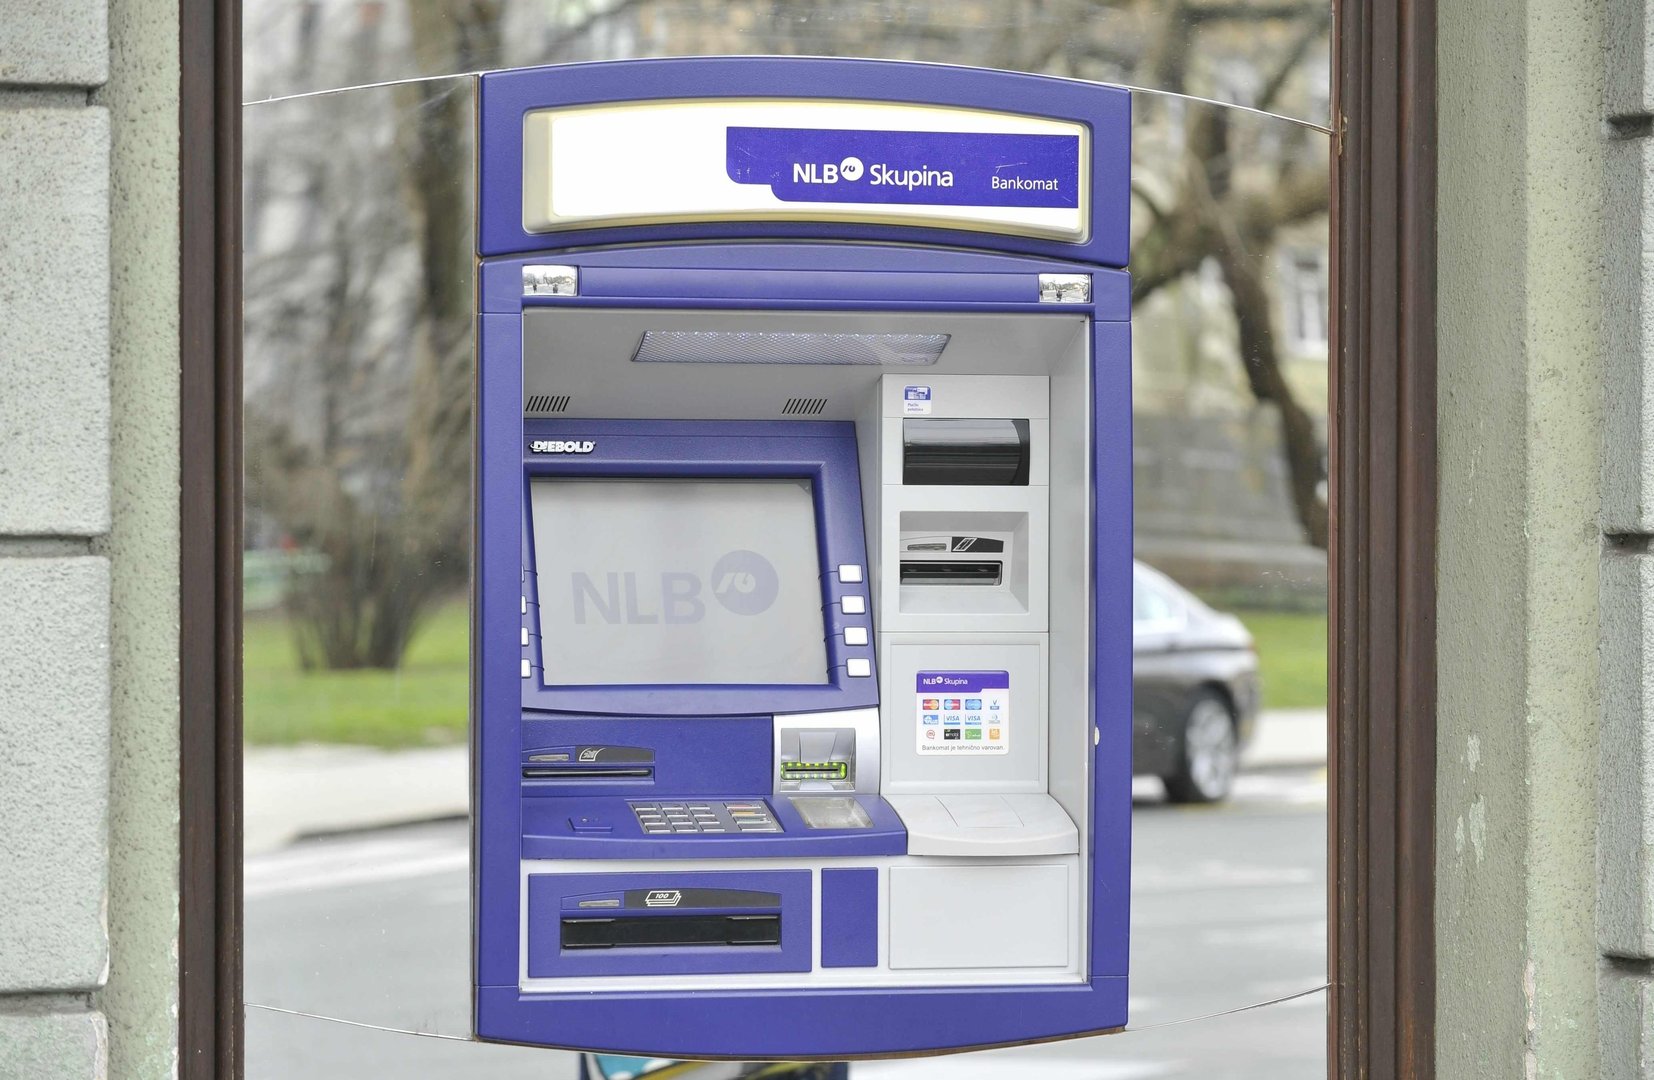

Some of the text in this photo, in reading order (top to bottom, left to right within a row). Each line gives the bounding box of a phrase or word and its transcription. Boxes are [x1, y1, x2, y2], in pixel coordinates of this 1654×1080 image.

[793, 163, 1059, 191] NLB Skupina Bankomat
[530, 441, 595, 453] DIEBOLD
[571, 571, 706, 625] NLB
[944, 677, 968, 686] Skupina
[951, 744, 956, 752] je
